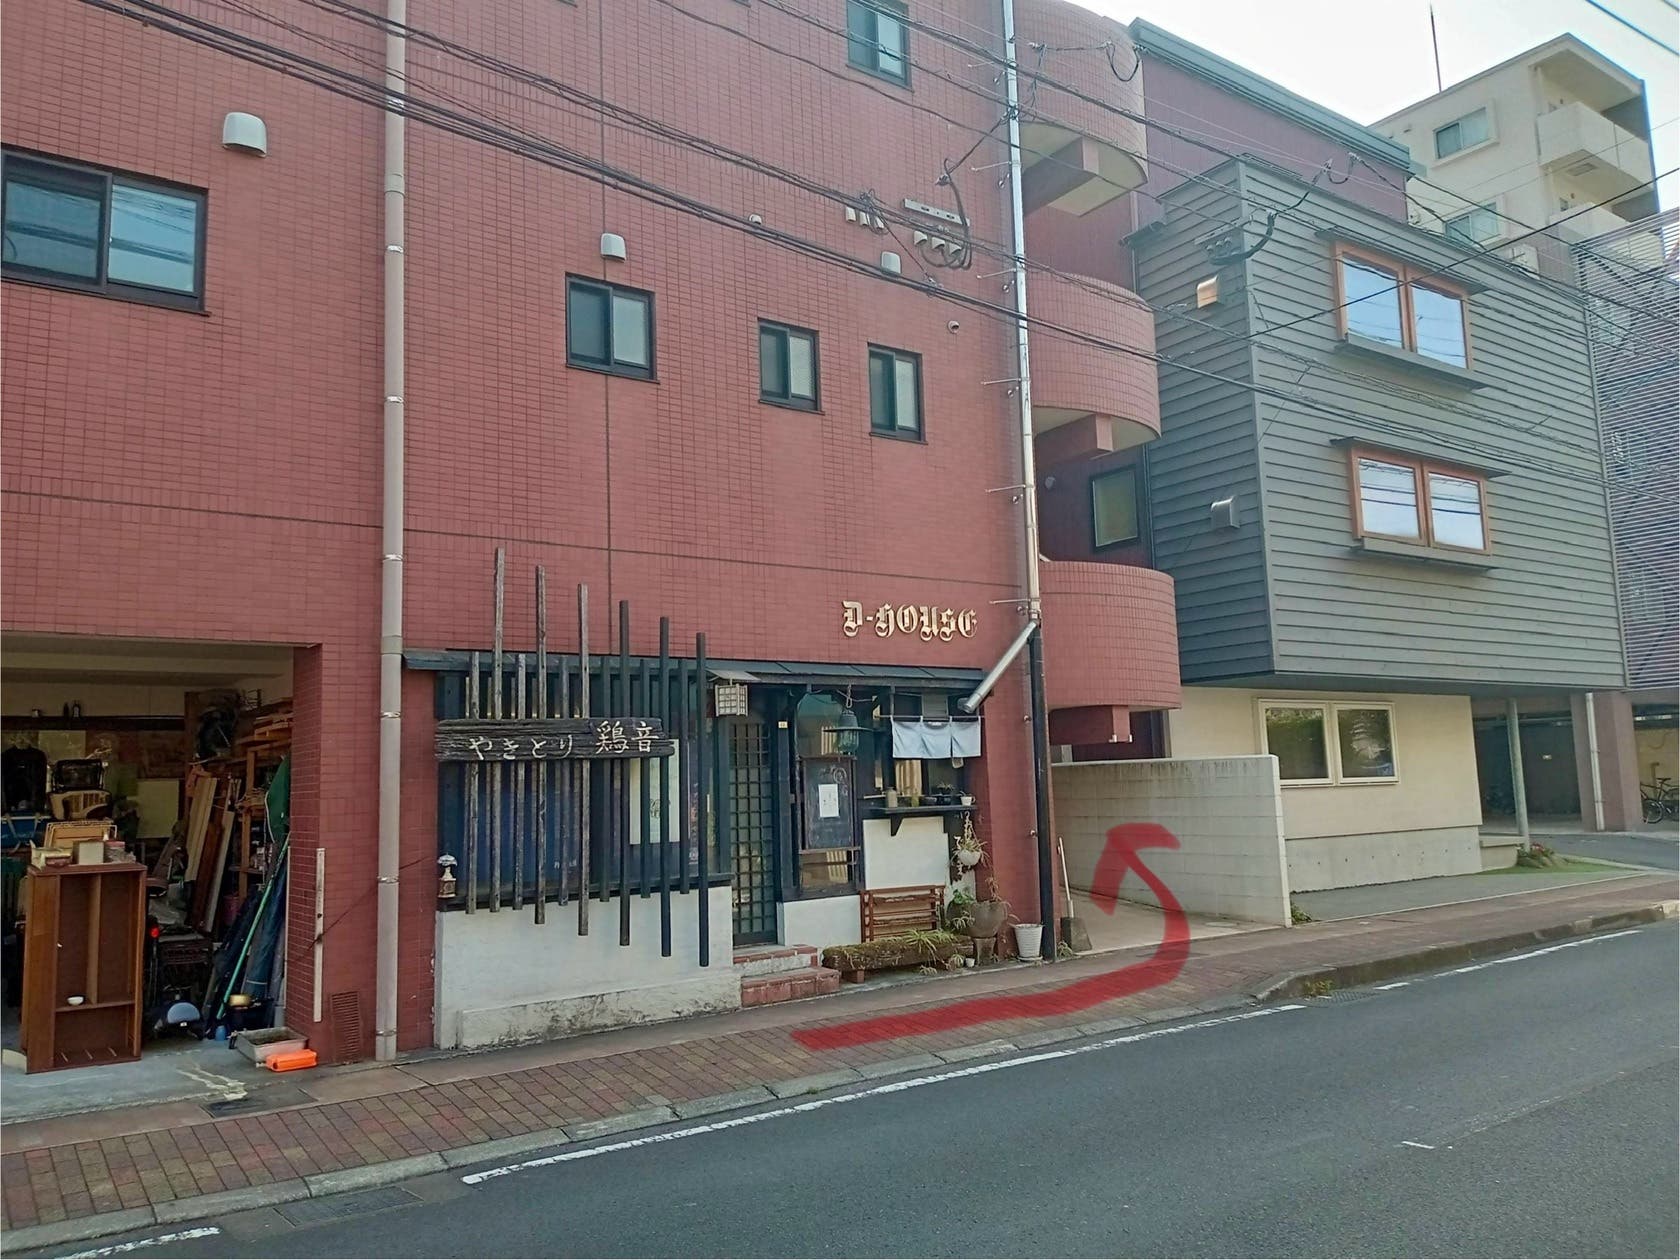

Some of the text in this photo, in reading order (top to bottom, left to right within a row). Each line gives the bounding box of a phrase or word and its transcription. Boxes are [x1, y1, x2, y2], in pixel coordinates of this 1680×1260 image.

[842, 600, 978, 641] D-HOUSE
[469, 720, 660, 761] やきとり 鶏音
